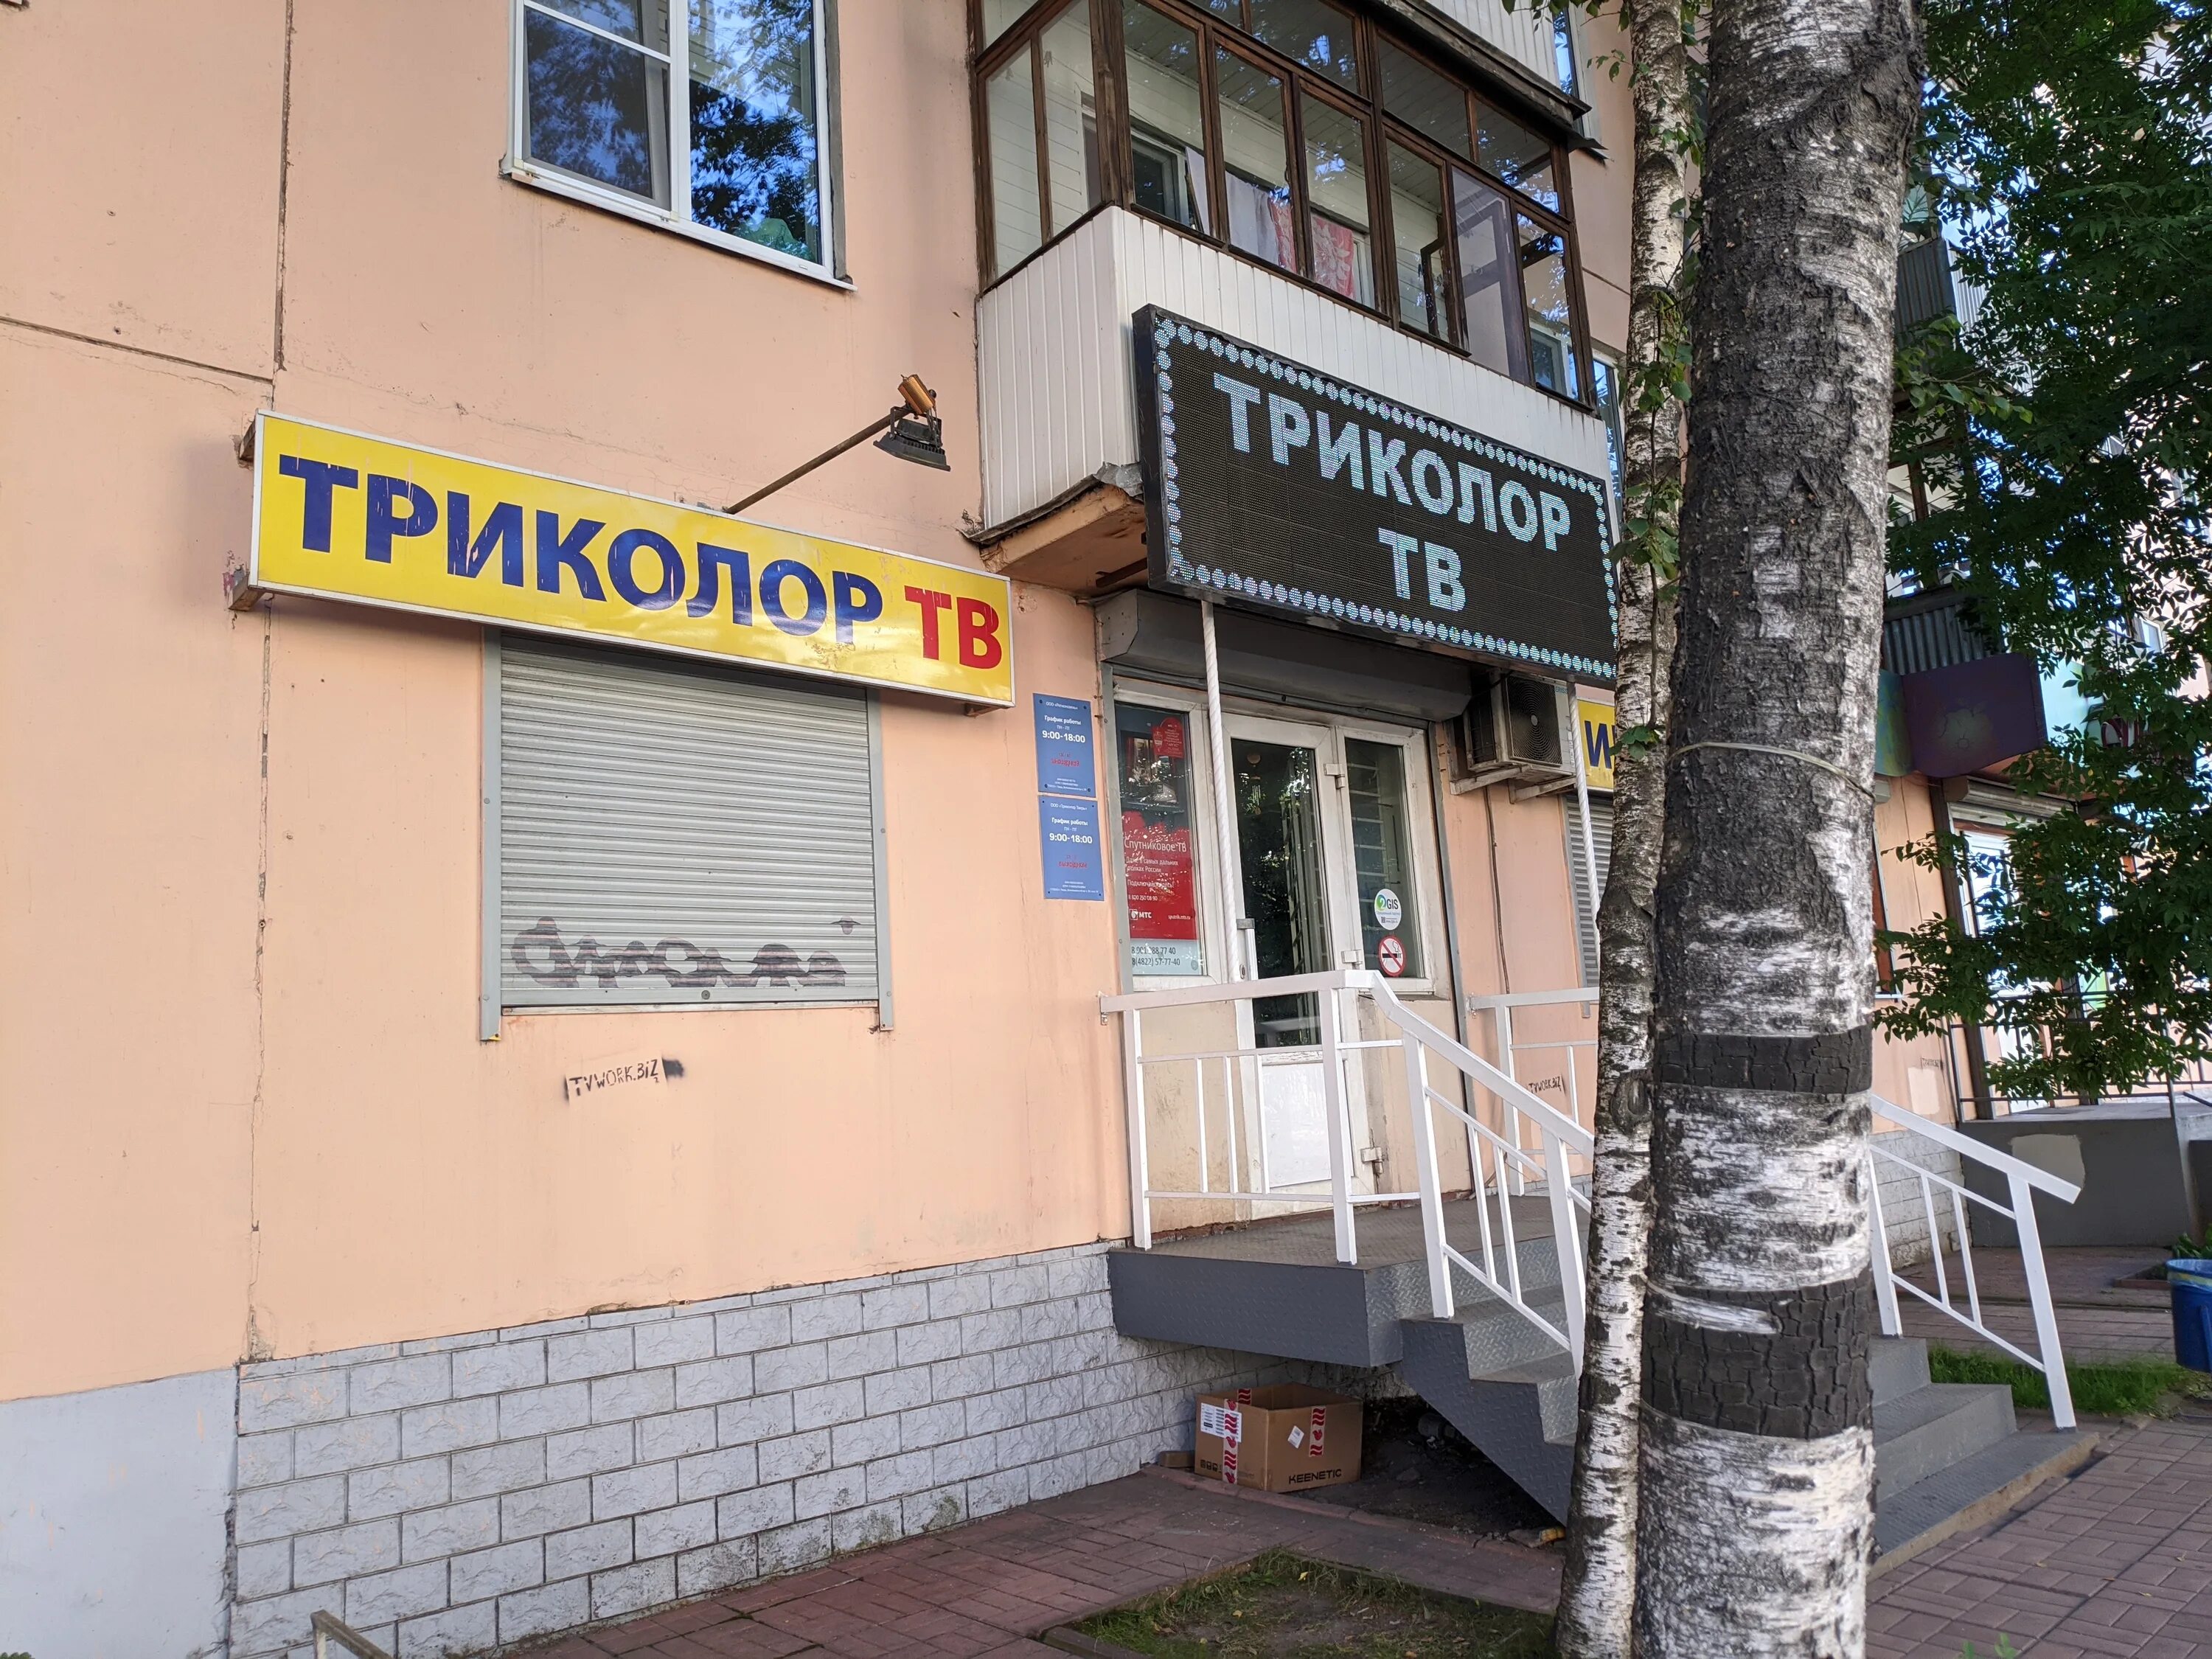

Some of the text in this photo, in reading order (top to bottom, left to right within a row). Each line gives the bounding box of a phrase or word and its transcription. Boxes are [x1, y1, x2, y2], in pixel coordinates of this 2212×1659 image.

[1214, 373, 1571, 551] ТРИКОЛОР
[279, 455, 1002, 669] ТРИКОЛОР ТВ
[1378, 527, 1466, 612] ТВ
[1042, 730, 1085, 743] 9:00-18:00
[1049, 832, 1093, 844] 9:00-18:00
[1124, 838, 1187, 852] Спутниковое ТВ
[1377, 894, 1399, 910] 2GIS
[1147, 946, 1159, 954] 88
[1161, 947, 1167, 955] 77
[1169, 947, 1176, 955] 40
[1155, 958, 1180, 966] 57-77-40
[1289, 1469, 1342, 1485] KEENETIC
